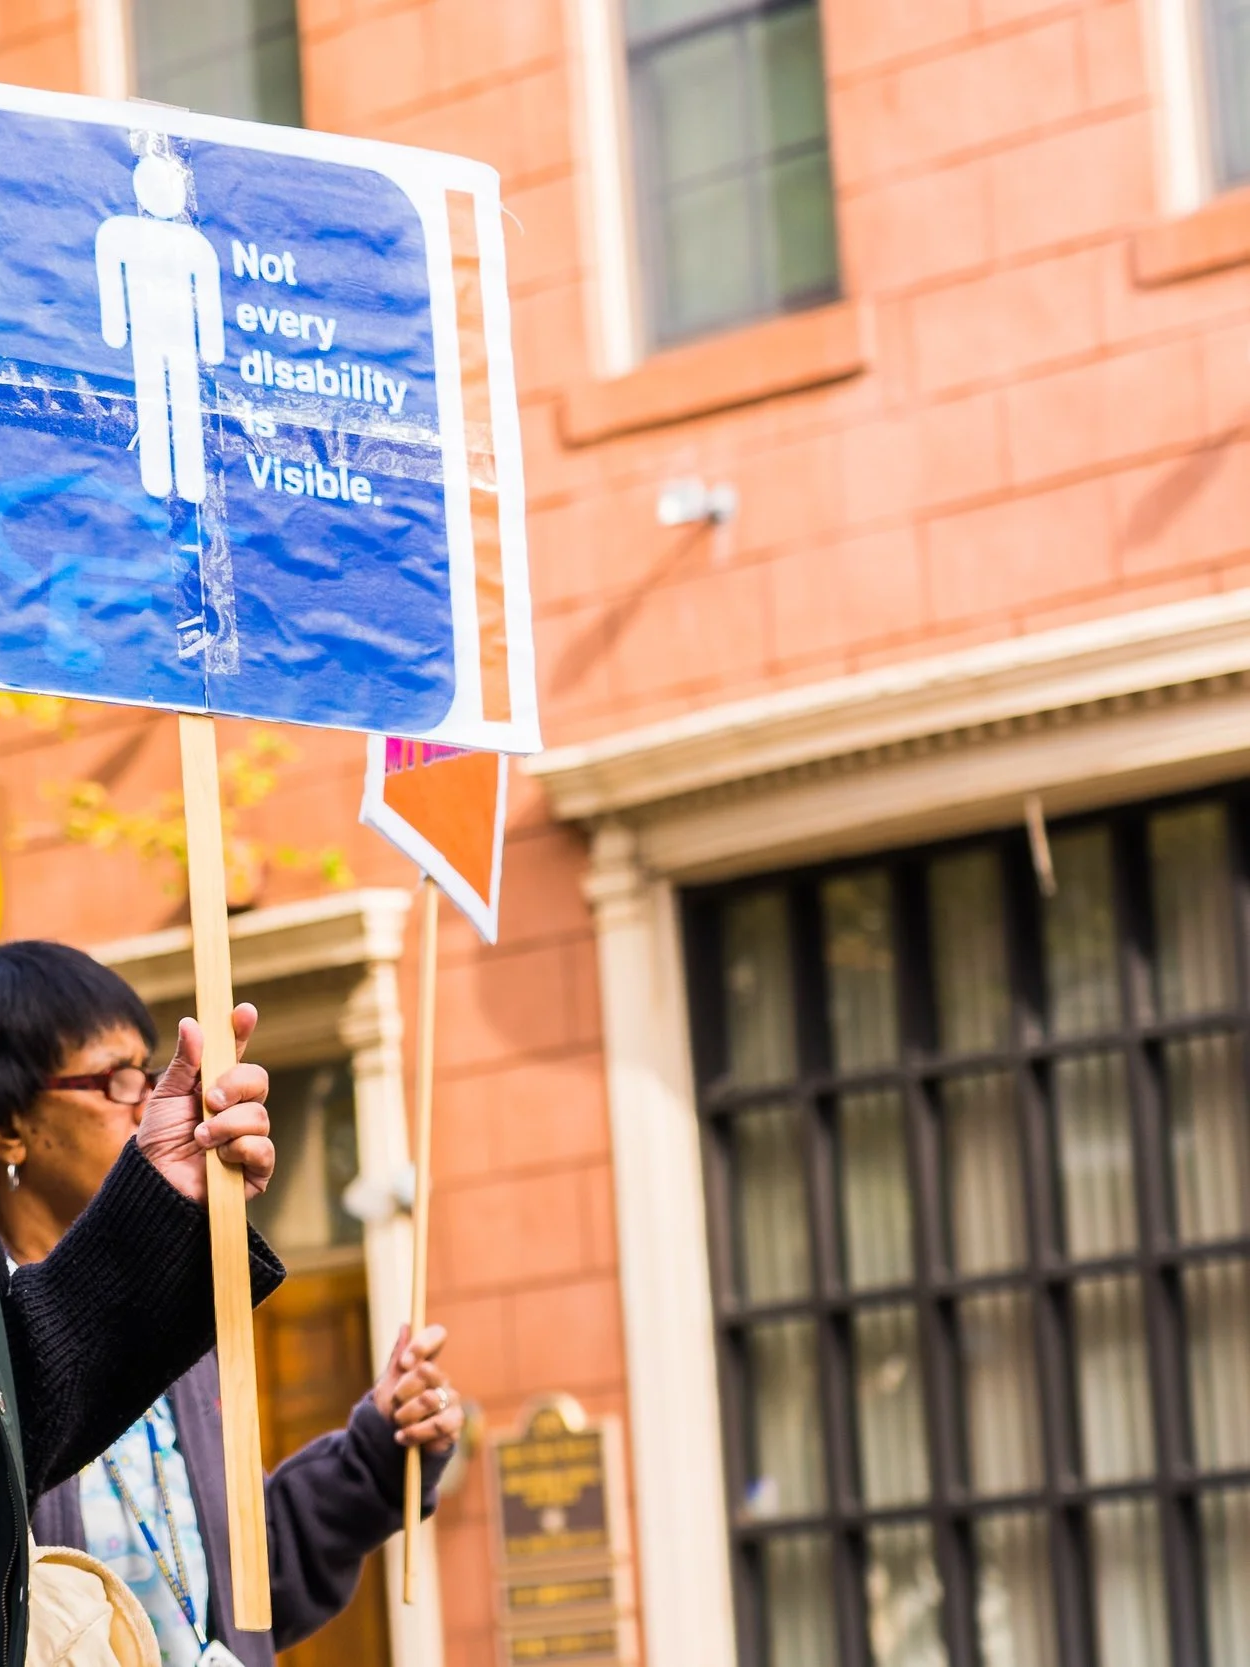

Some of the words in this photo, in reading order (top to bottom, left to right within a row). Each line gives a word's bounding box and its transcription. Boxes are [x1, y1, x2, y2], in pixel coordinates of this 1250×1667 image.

[231, 239, 298, 286] Not
[236, 302, 336, 351] every
[240, 350, 407, 415] disability
[244, 400, 277, 438] is
[246, 453, 383, 507] Visible.
